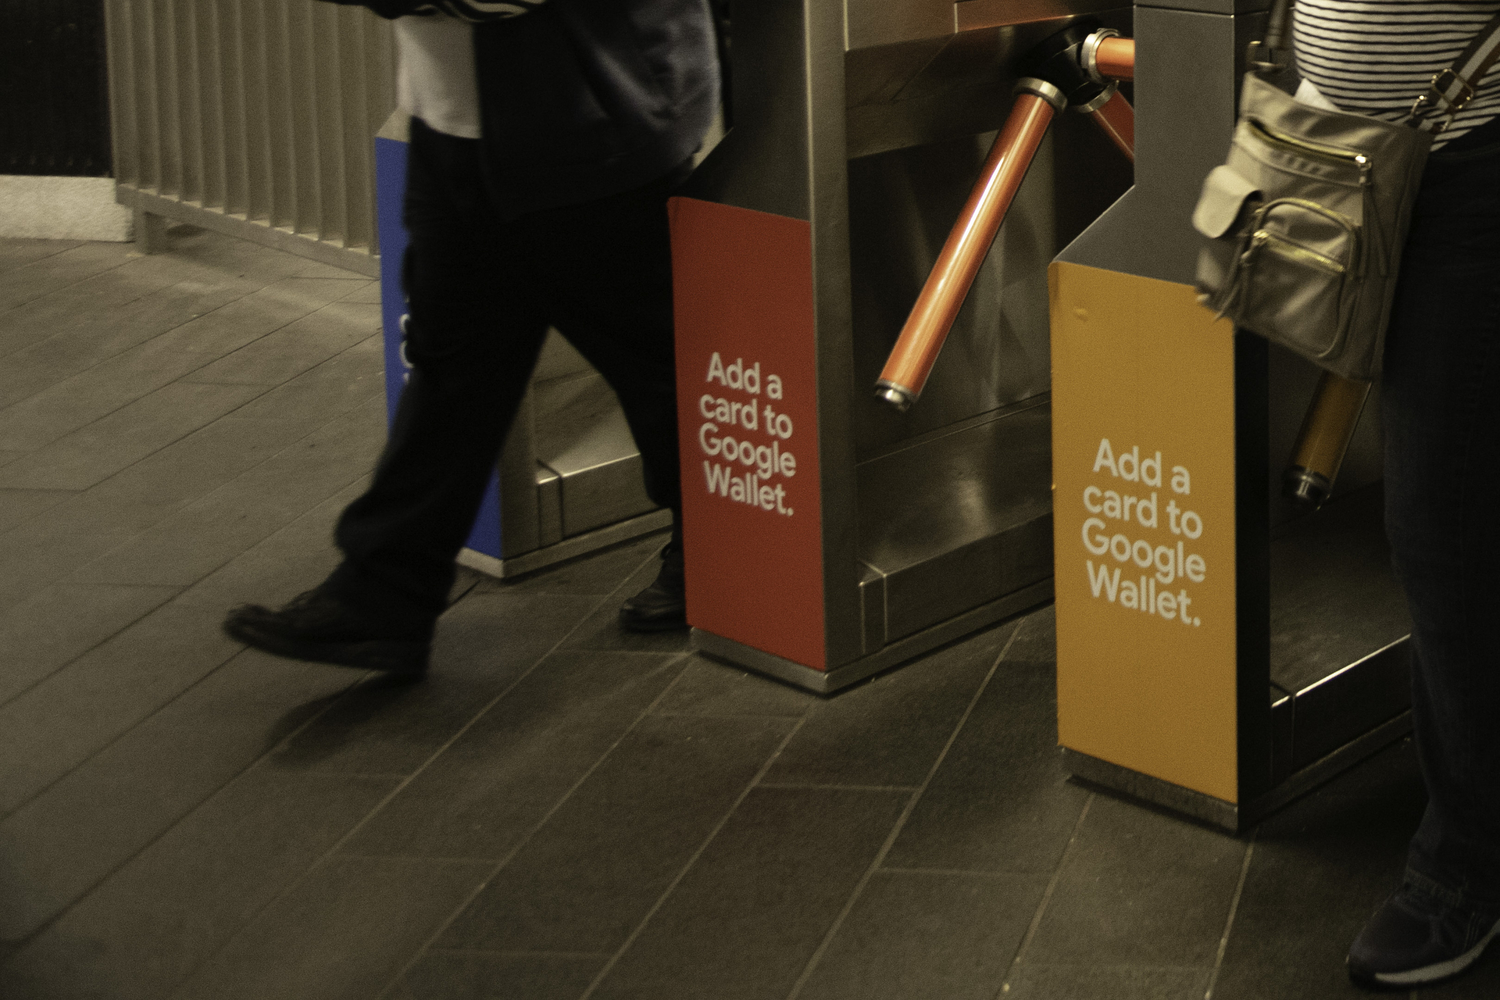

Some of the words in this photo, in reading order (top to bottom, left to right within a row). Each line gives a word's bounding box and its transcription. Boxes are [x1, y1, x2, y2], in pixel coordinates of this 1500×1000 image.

[706, 351, 760, 395] Add
[766, 373, 783, 400] a
[700, 394, 758, 431] card
[763, 404, 793, 440] to
[699, 422, 797, 480] Google
[1093, 438, 1162, 488] Add
[1171, 465, 1190, 495] a
[703, 460, 794, 517] Wallet.
[1083, 485, 1158, 529] card
[1166, 500, 1203, 540] to
[1081, 517, 1206, 585] Google
[1086, 559, 1201, 628] Wallet.
